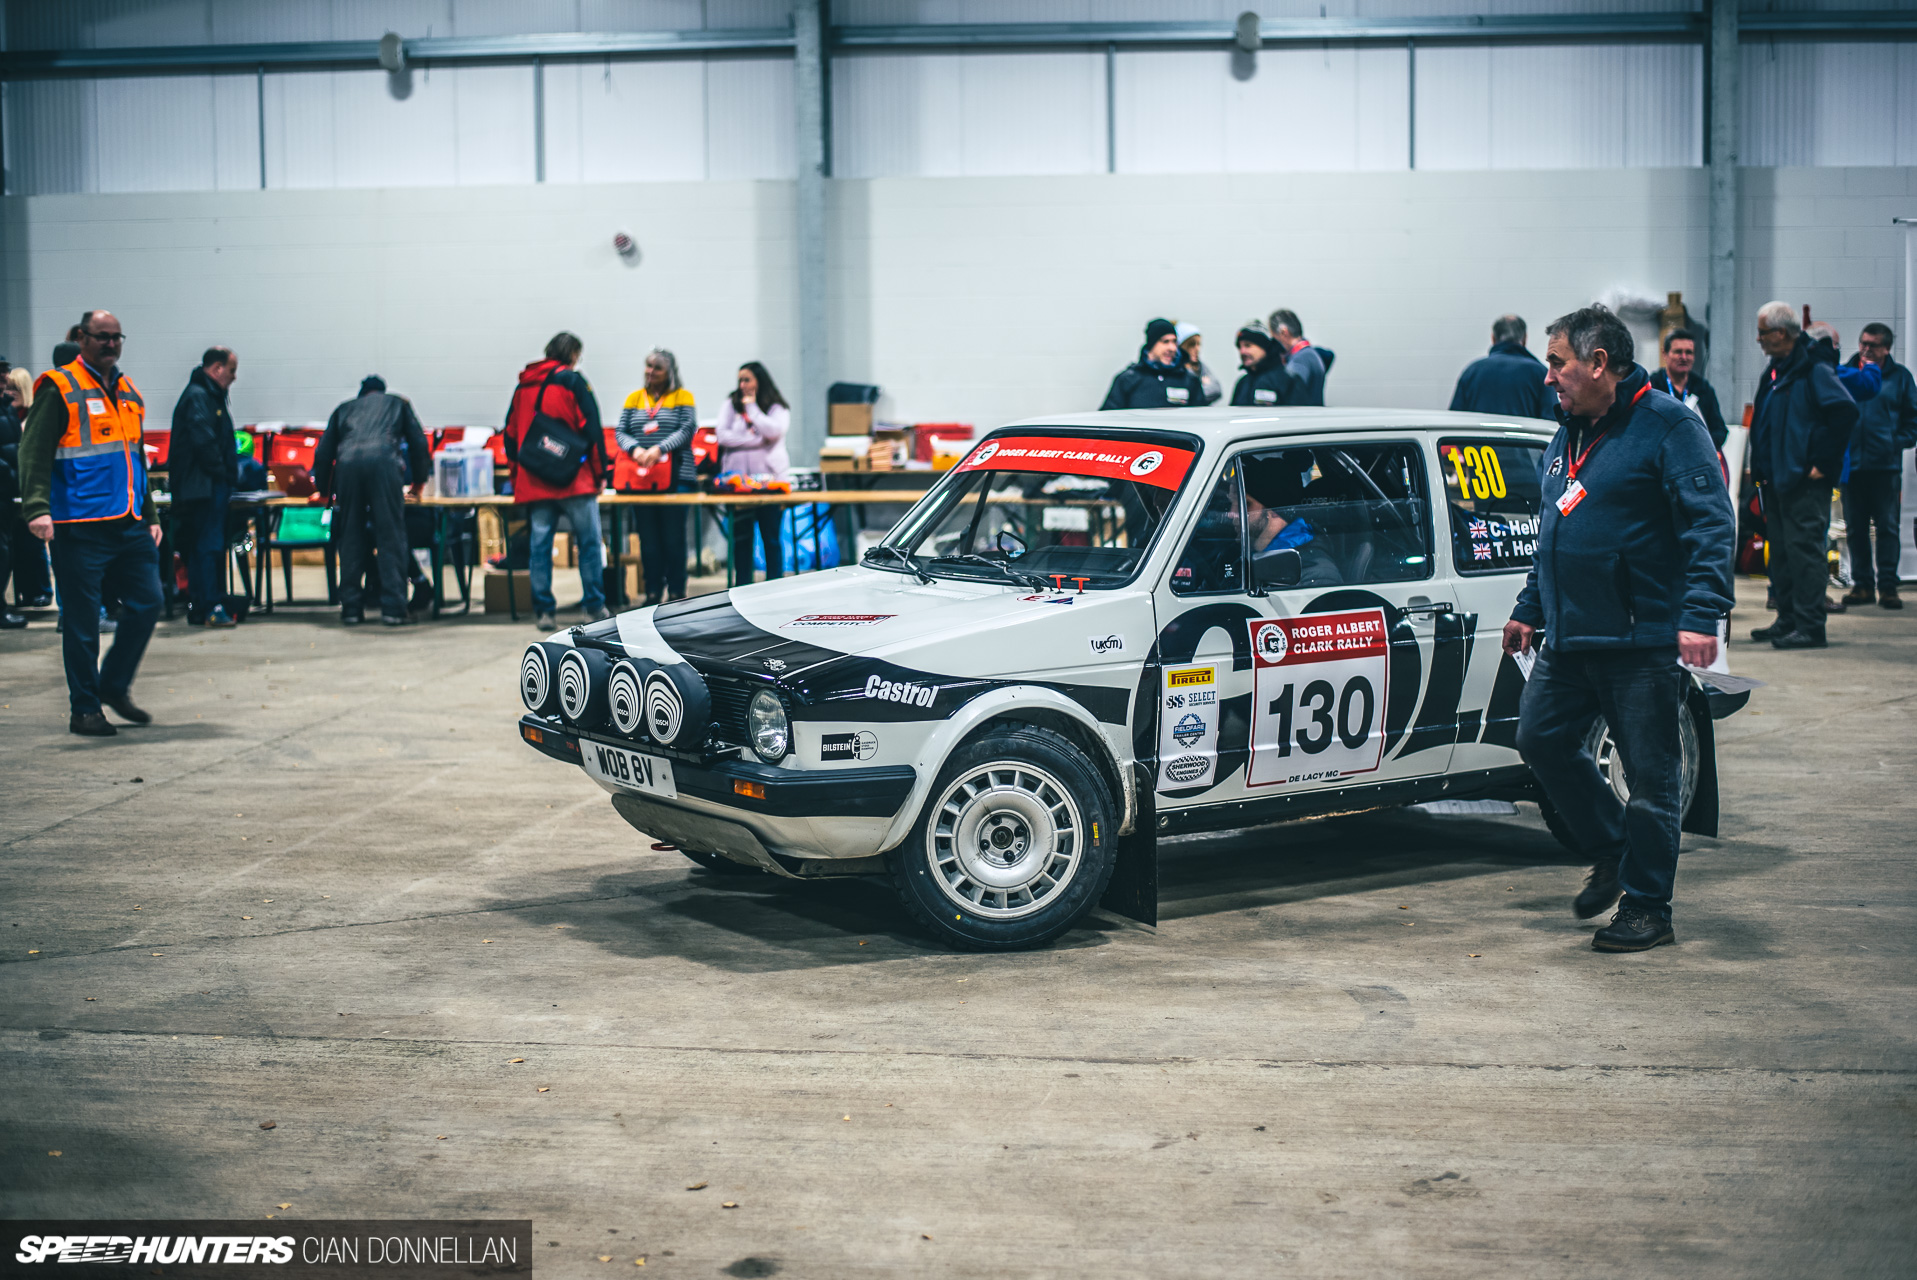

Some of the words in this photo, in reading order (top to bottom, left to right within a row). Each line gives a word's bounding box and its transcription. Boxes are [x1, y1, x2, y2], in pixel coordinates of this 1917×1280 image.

[996, 448, 1028, 457] ROGER
[1025, 449, 1065, 459] ALBERT
[1062, 450, 1097, 461] CLARK
[1095, 453, 1132, 464] RALLY
[1448, 445, 1507, 499] 130
[1490, 521, 1507, 538] C.
[1493, 541, 1510, 558] T.
[1512, 539, 1539, 557] Hel
[1291, 624, 1333, 639] ROGER
[1336, 620, 1380, 635] ALBERT
[1293, 639, 1334, 654] CLARK
[1336, 636, 1374, 651] RALLY
[1171, 670, 1212, 685] PIRELLI
[864, 674, 940, 709] Castrol
[1188, 690, 1217, 702] SELECT
[655, 718, 669, 727] BOSCH
[1269, 675, 1375, 758] 130
[822, 743, 851, 752] BILSTEIN
[595, 745, 630, 781] WOB
[631, 754, 654, 787] 8V
[1171, 760, 1206, 770] SHERWOOD
[1288, 775, 1301, 783] DE
[1301, 771, 1325, 781] LACY
[1325, 769, 1339, 778] MC
